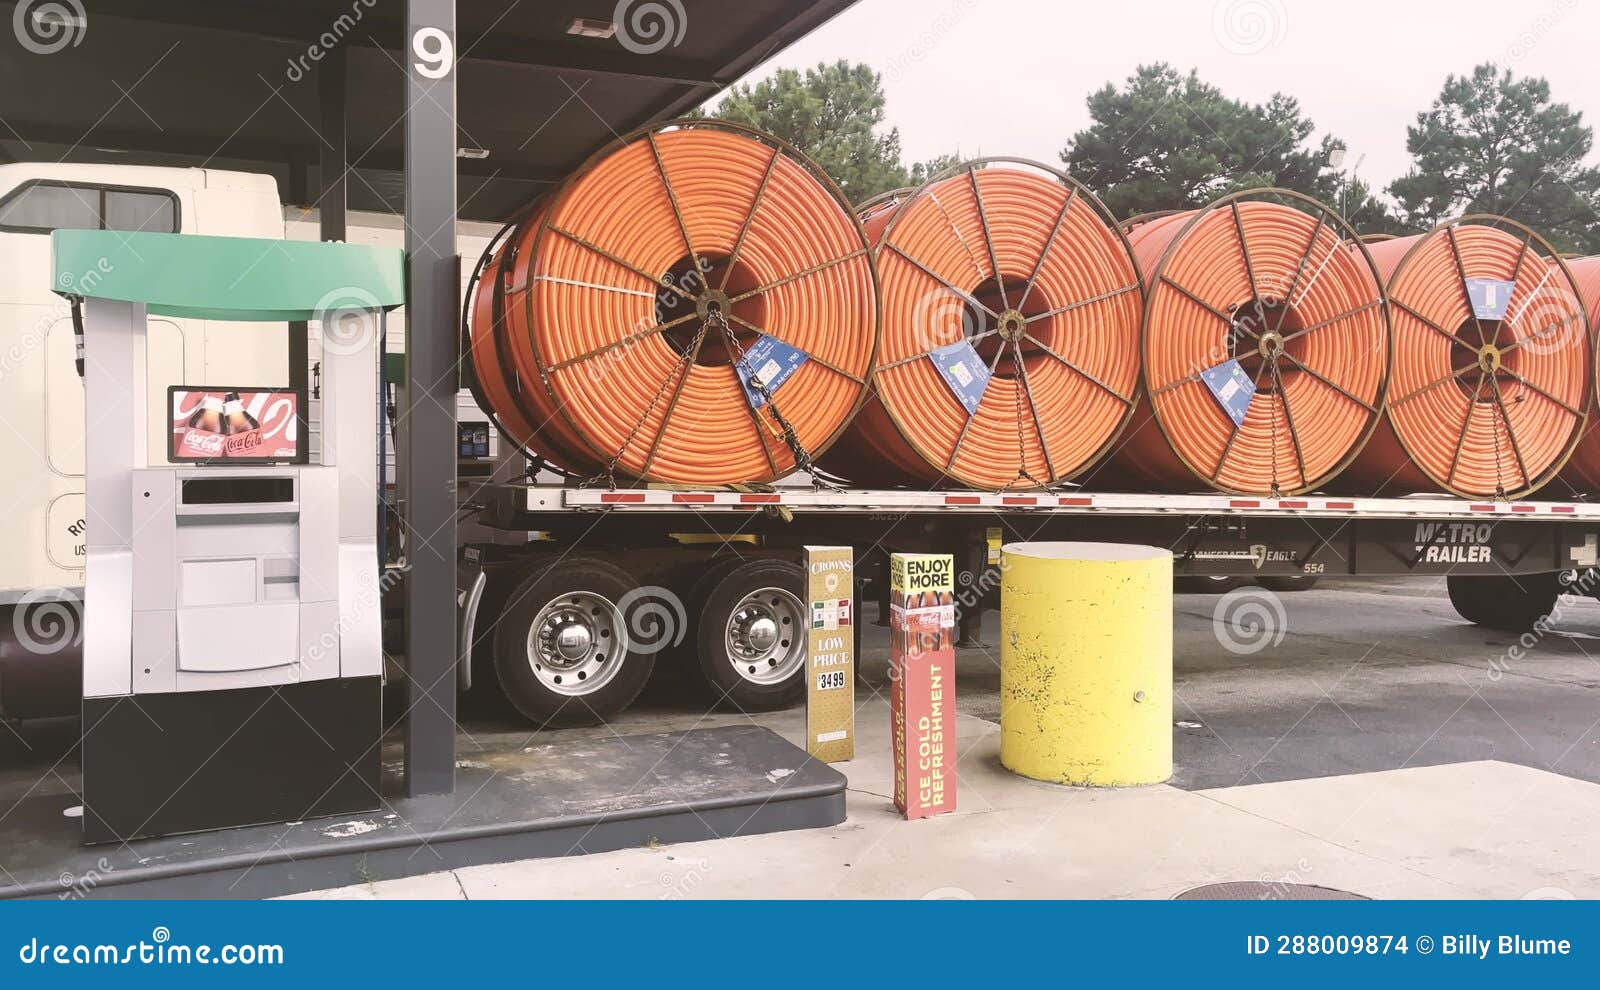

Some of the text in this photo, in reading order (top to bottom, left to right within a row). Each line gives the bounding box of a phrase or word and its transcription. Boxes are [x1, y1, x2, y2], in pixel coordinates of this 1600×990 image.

[412, 27, 454, 79] 9
[1266, 551, 1297, 561] EAGLE
[811, 560, 852, 575] CROWNS
[907, 558, 951, 575] ENJOY
[1303, 563, 1325, 574] 554
[910, 573, 949, 589] MORE
[818, 637, 844, 651] LOW
[813, 652, 850, 668] PRICE
[930, 664, 944, 806] REFRESHMENT
[919, 716, 931, 808] ICE COLD
